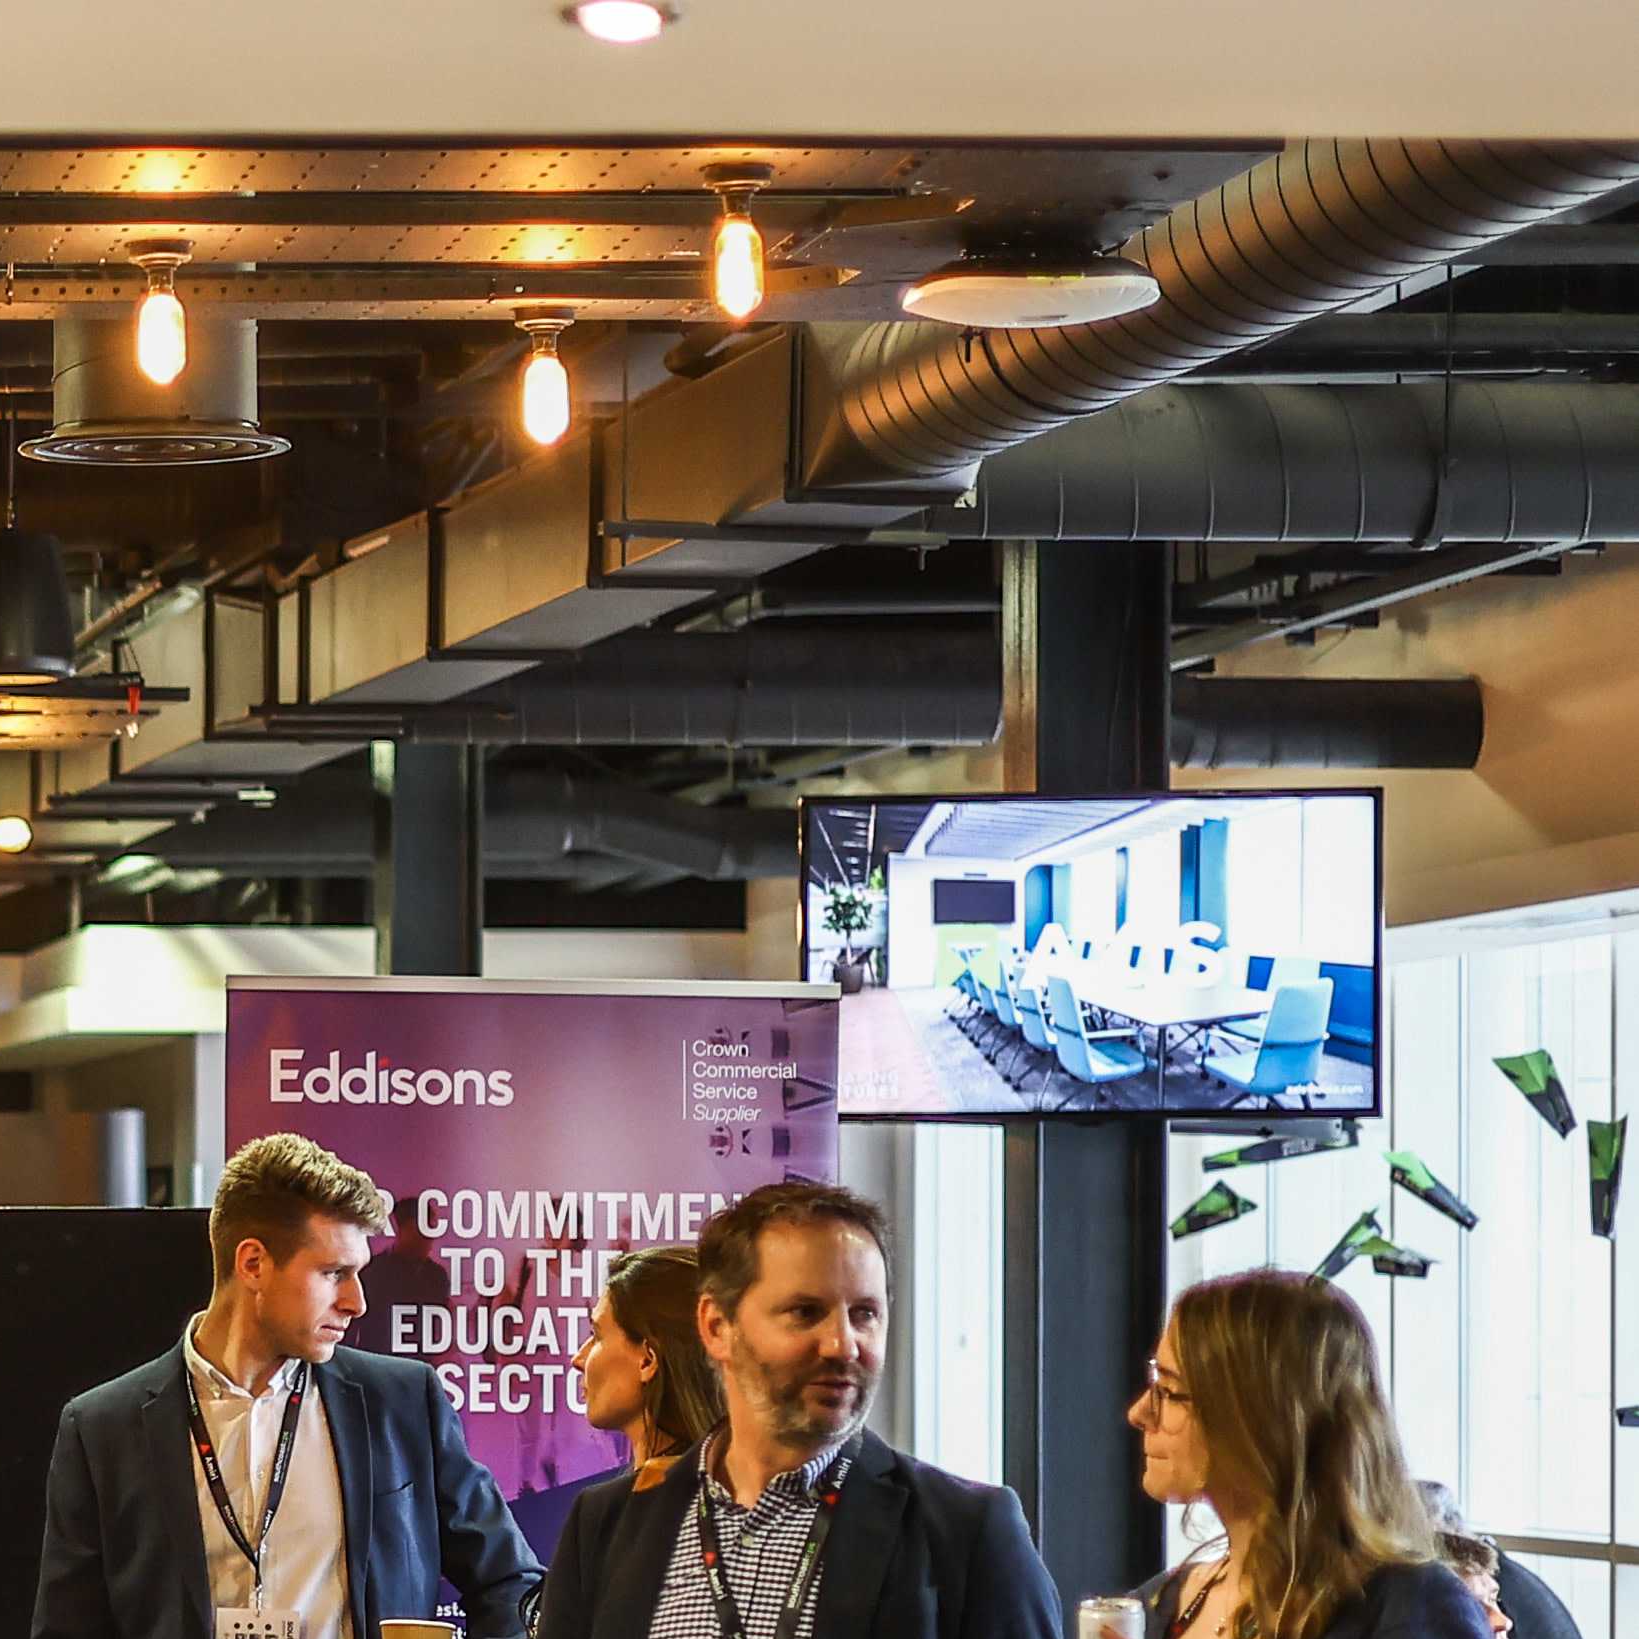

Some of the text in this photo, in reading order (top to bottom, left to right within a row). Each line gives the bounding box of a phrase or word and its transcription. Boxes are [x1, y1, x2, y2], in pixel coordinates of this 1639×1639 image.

[692, 1039, 749, 1058] Crown
[269, 1048, 515, 1107] Eddisons
[692, 1060, 798, 1080] Commercial
[692, 1081, 759, 1101] Service
[692, 1103, 762, 1125] Supplier
[440, 1247, 506, 1298] TO
